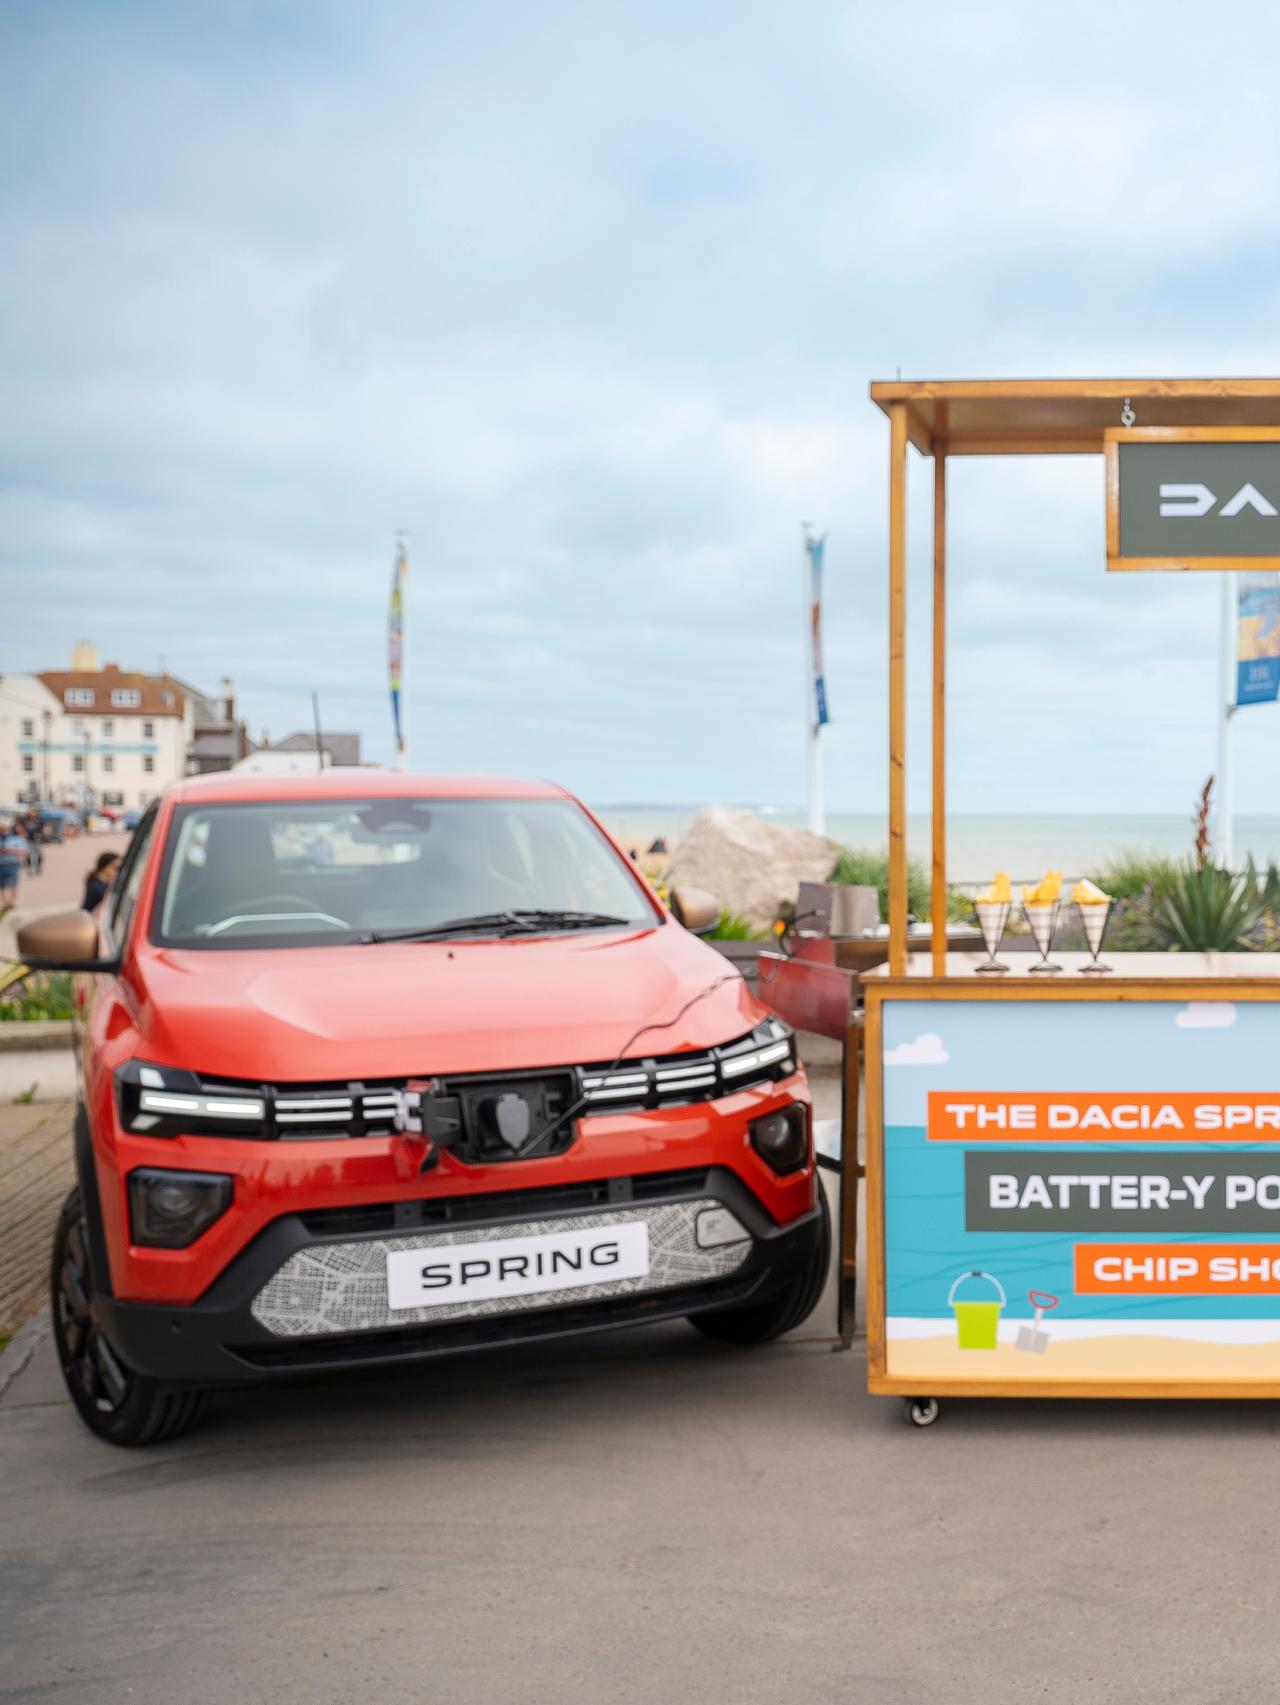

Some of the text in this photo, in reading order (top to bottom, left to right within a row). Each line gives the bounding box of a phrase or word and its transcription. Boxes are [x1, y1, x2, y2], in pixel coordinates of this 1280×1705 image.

[944, 1104, 1036, 1129] THE
[1047, 1104, 1185, 1130] DACIA
[989, 1174, 1215, 1209] BATTER-Y
[421, 1242, 620, 1289] SPRING
[1093, 1256, 1199, 1282] CHIP
